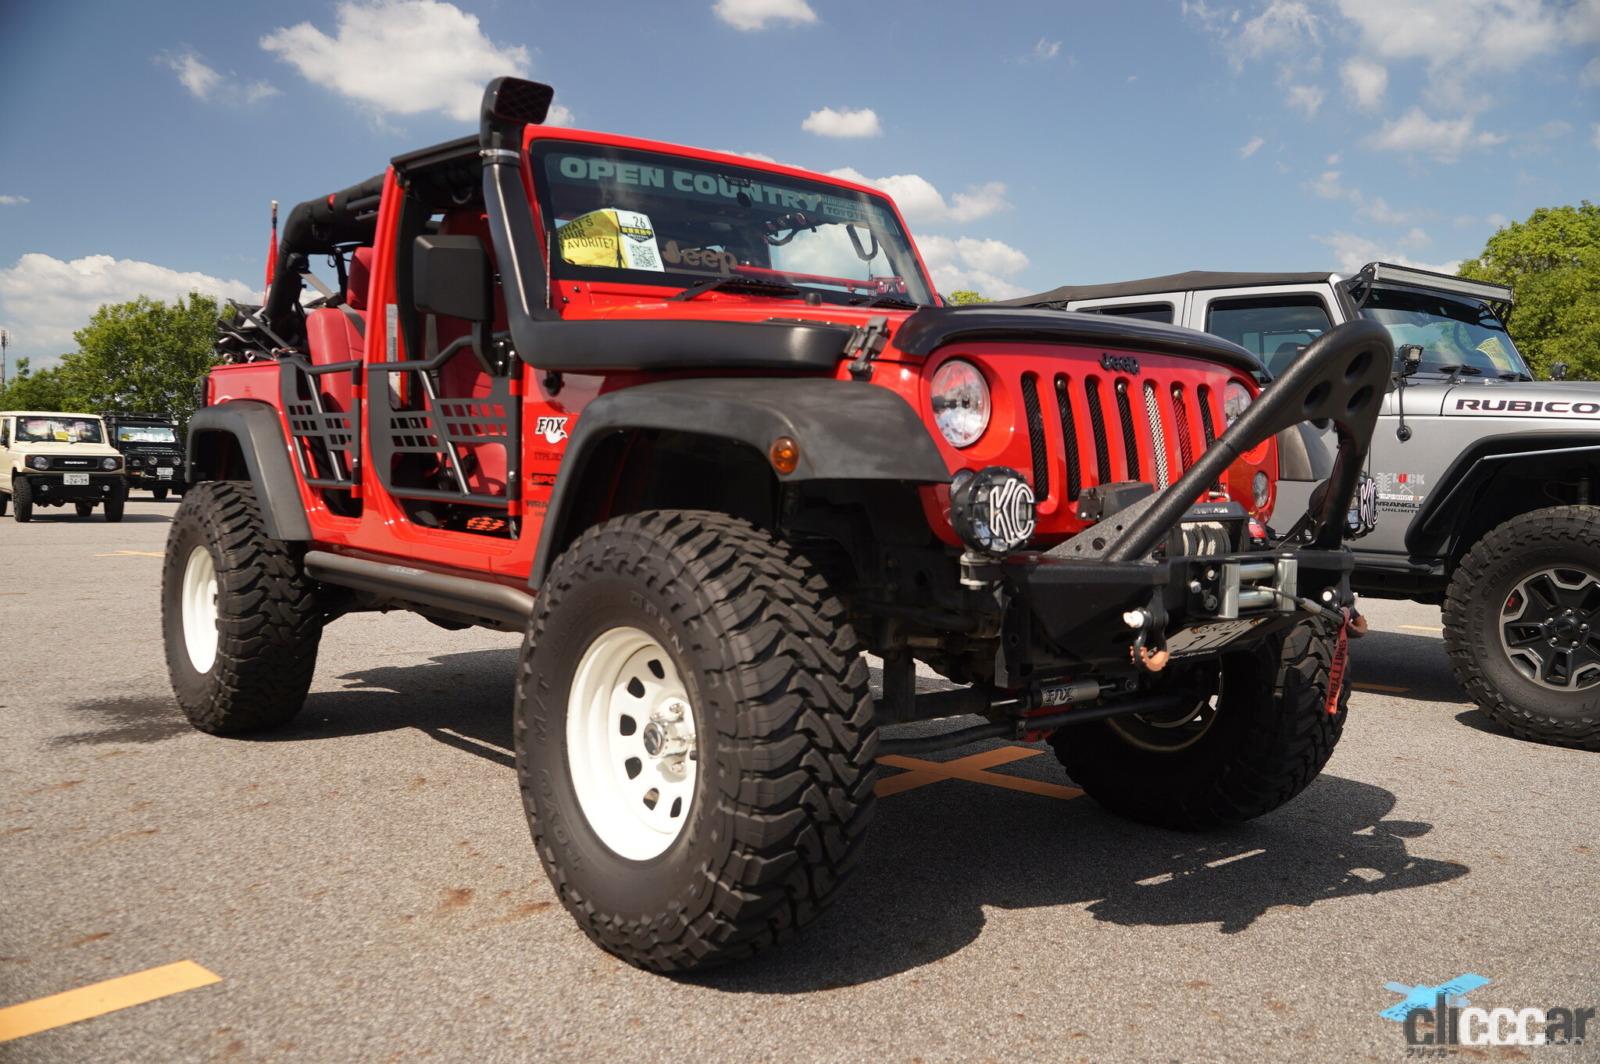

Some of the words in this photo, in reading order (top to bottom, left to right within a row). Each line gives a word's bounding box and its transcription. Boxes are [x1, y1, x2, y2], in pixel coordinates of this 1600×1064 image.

[560, 157, 664, 188] OPEN
[672, 171, 821, 211] COUNTRY
[632, 215, 646, 228] 26
[1100, 352, 1139, 375] Jeep
[537, 418, 565, 434] FOX
[990, 478, 1034, 544] KC
